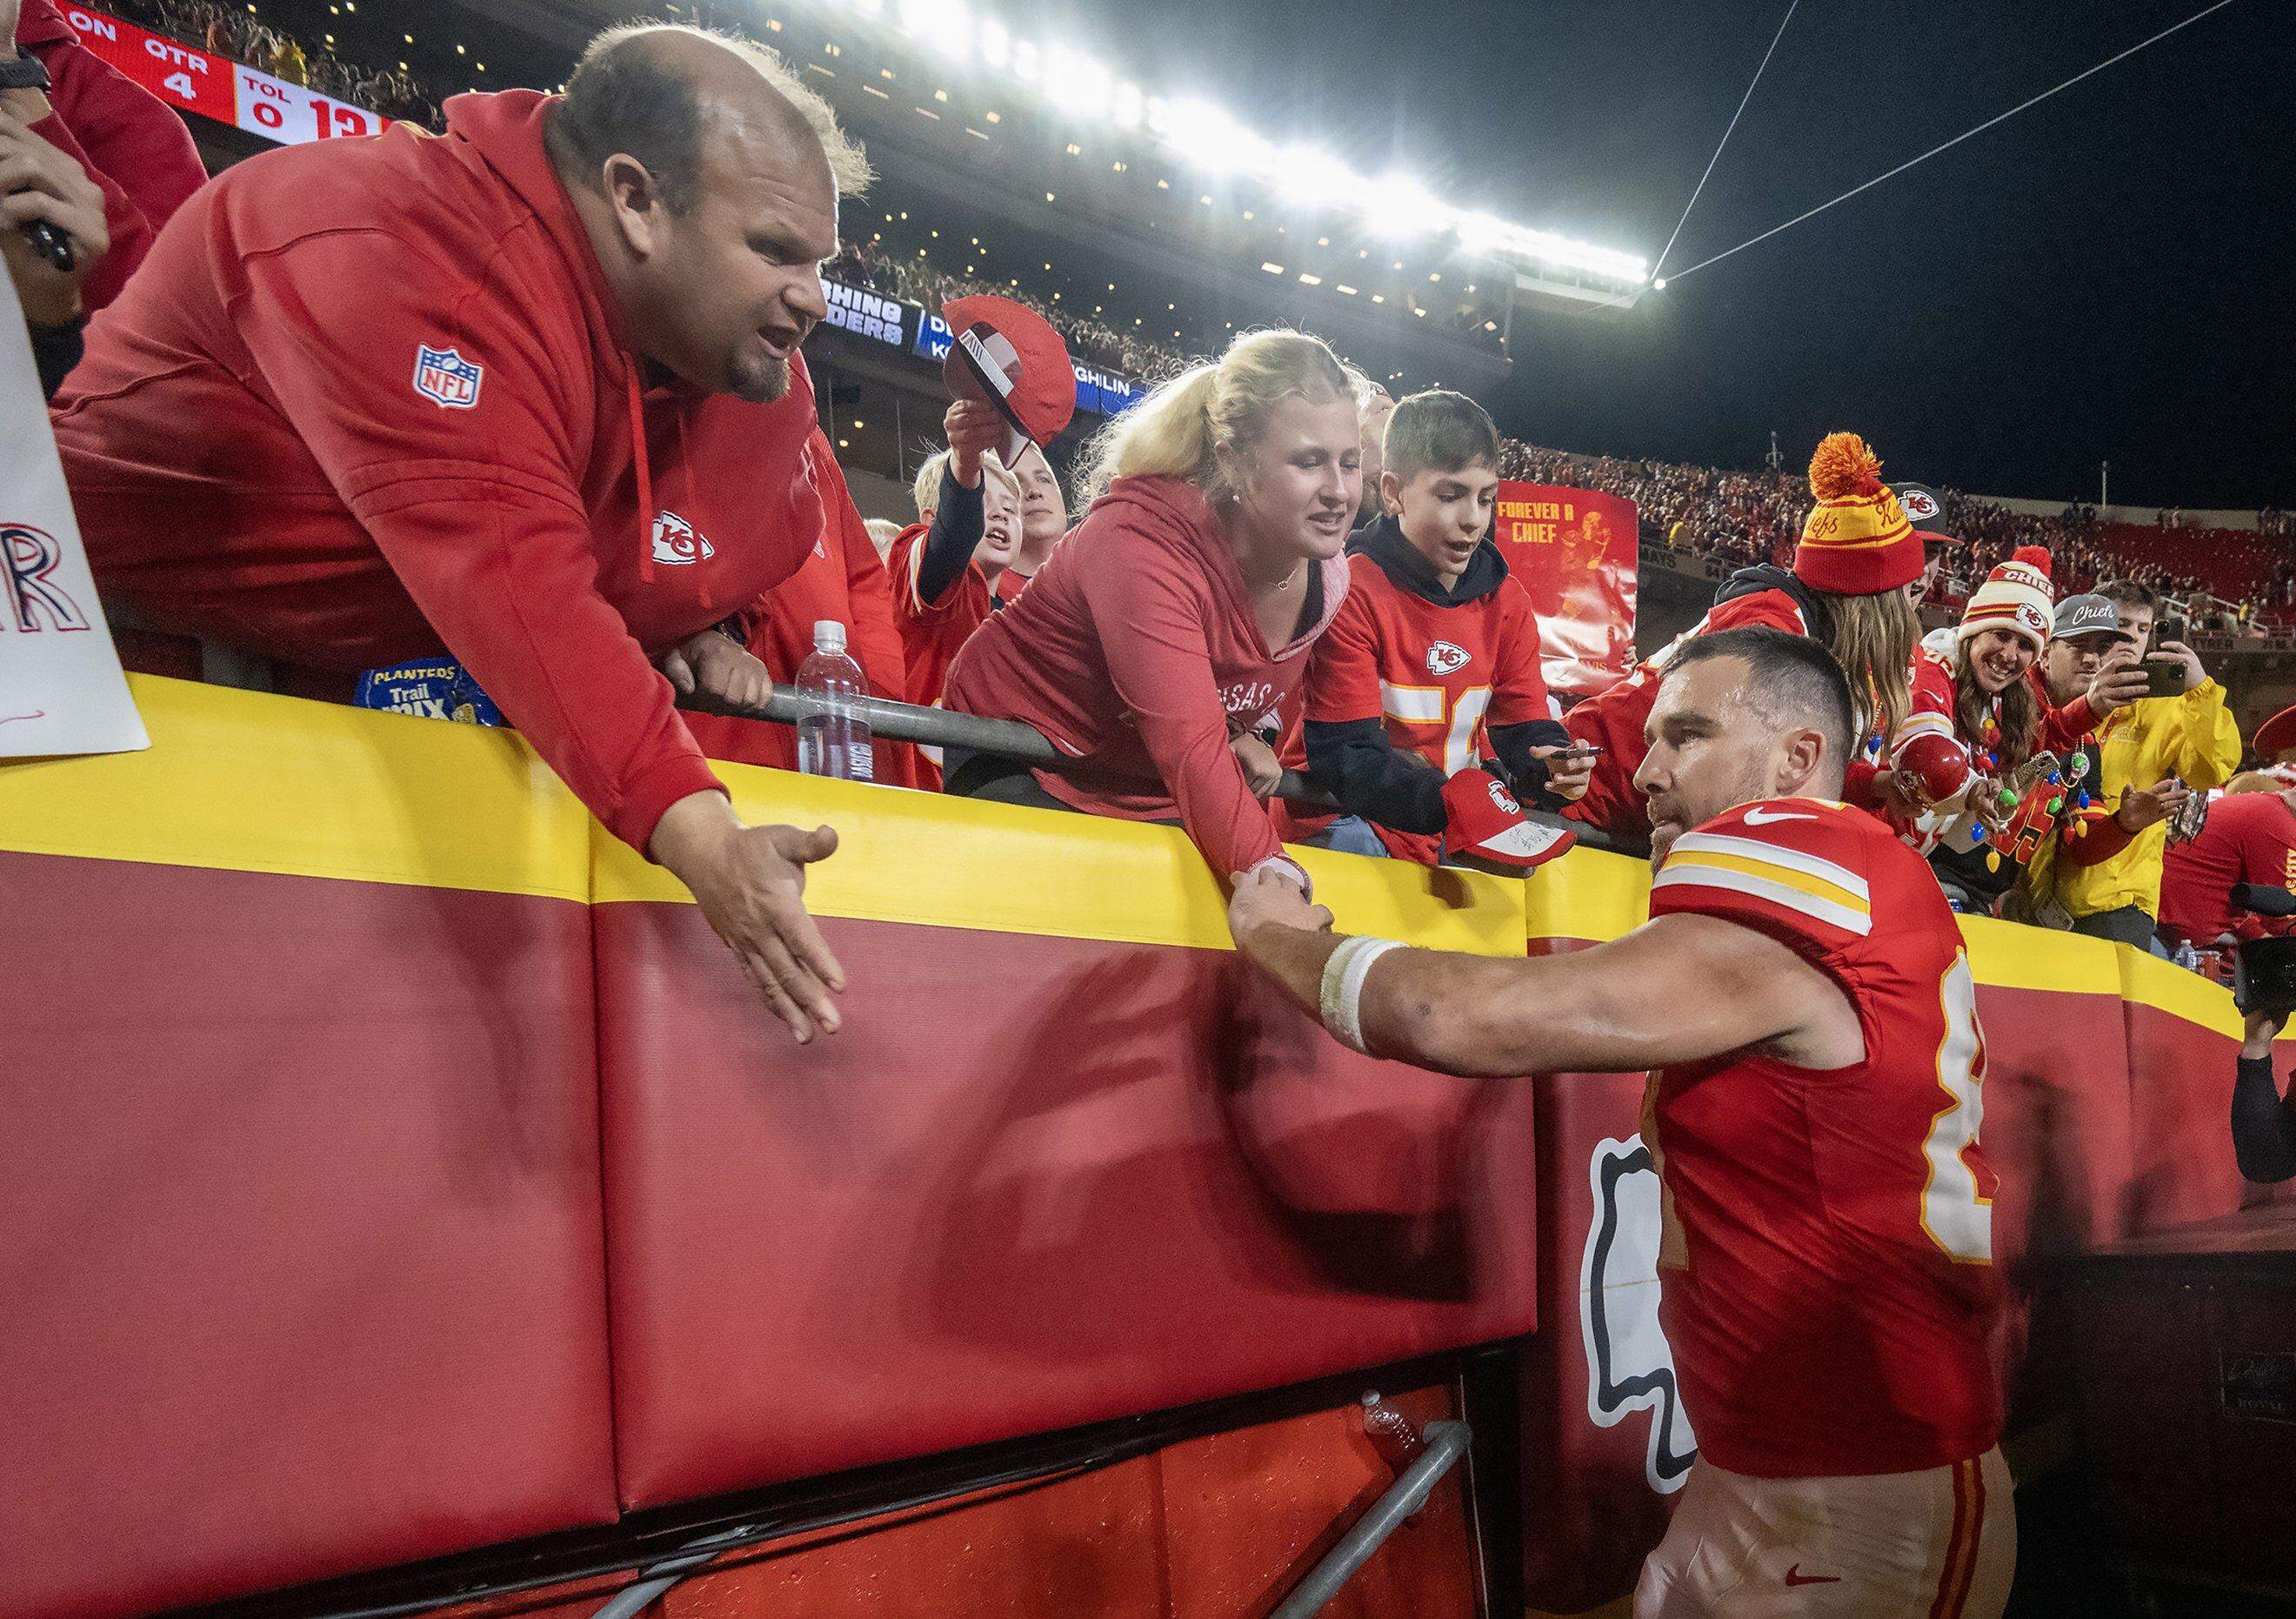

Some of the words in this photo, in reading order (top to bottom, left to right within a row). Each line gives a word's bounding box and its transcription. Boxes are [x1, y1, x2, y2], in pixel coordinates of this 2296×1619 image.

[144, 38, 209, 76] QTR
[164, 71, 197, 100] 4
[243, 75, 292, 105] TOL
[423, 367, 470, 400] NFL
[1498, 501, 1560, 520] FOREVER
[1512, 521, 1557, 544] CHIEF
[1438, 648, 1461, 666] KC
[389, 683, 430, 704] Trail
